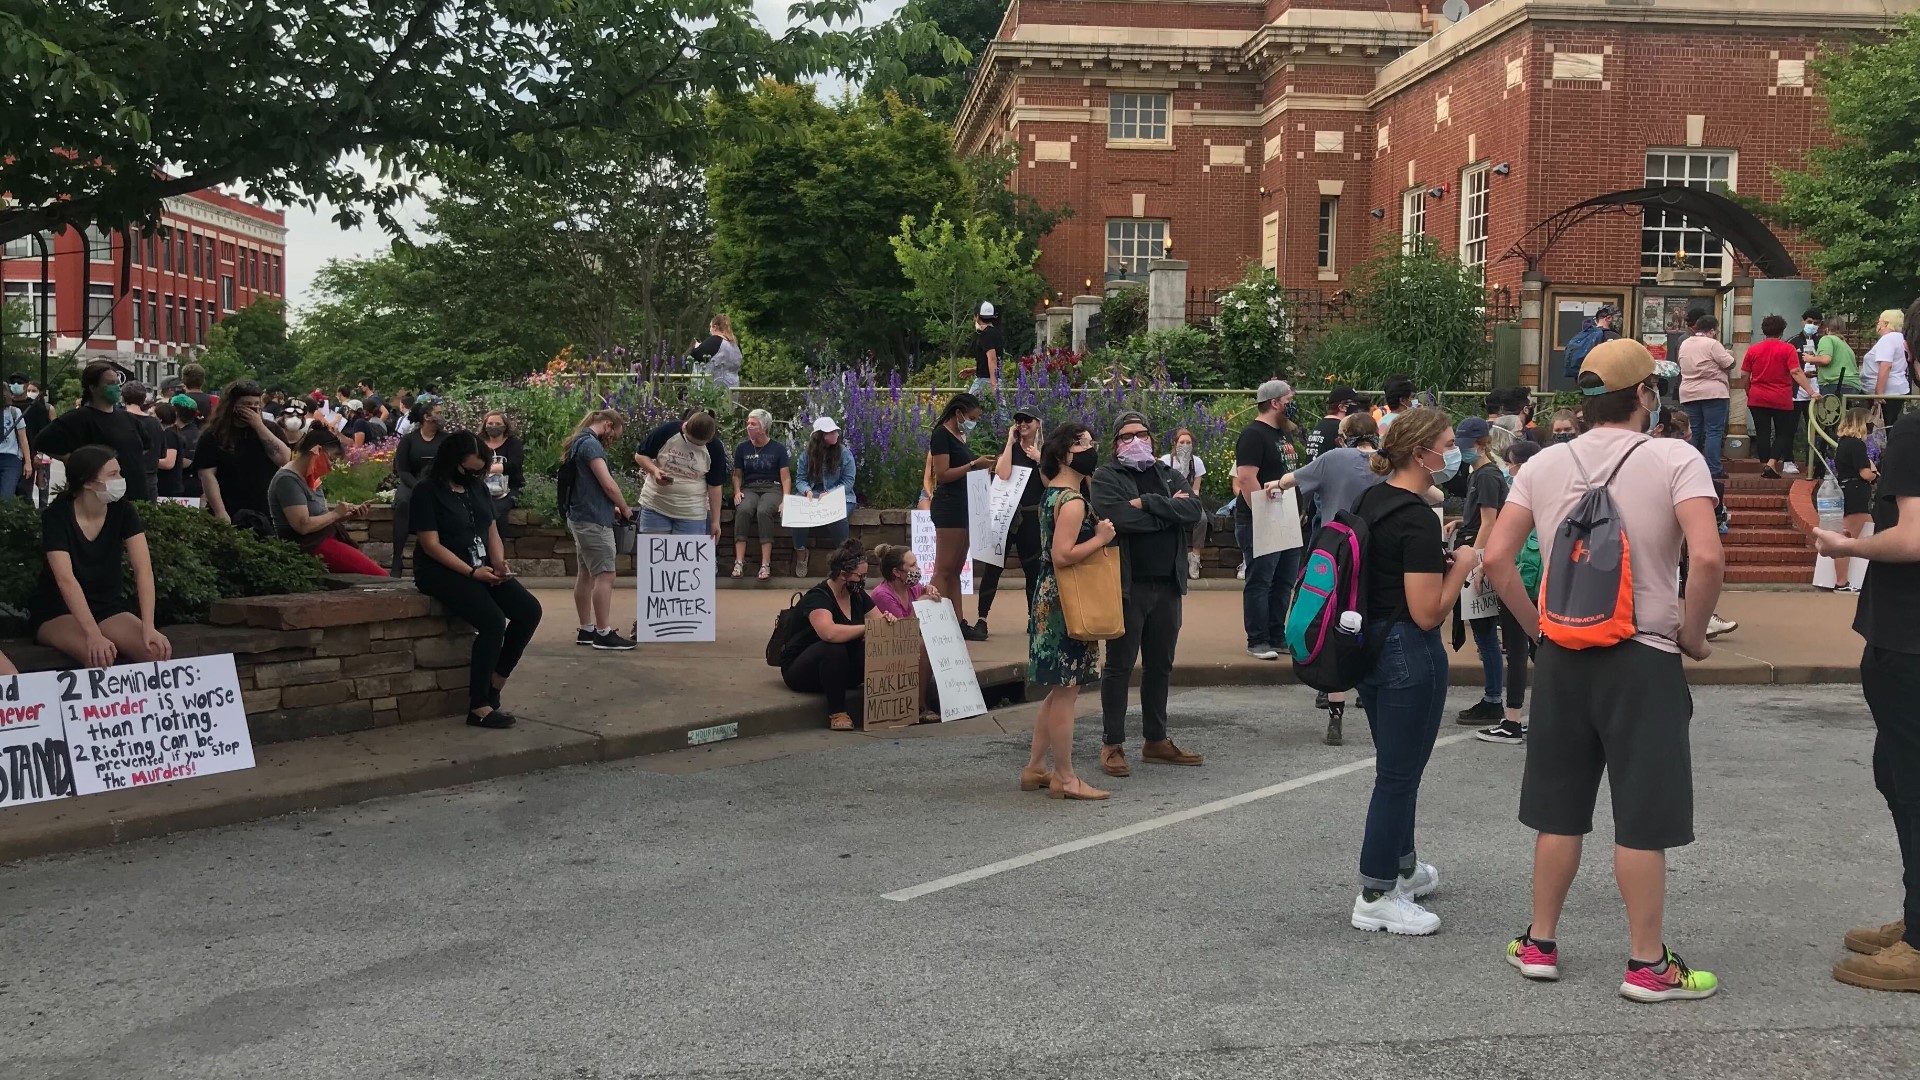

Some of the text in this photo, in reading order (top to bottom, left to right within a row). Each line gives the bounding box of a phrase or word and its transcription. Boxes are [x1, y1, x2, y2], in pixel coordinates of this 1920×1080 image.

[649, 537, 709, 565] BLACK
[649, 566, 701, 593] LIVES
[646, 595, 712, 620] MATTER.
[866, 619, 887, 638] ALL
[57, 661, 201, 701] 2 Reminders:
[866, 674, 896, 696] BLACK
[897, 670, 920, 690] LIVES
[83, 696, 148, 721] Murder
[157, 692, 174, 710] is
[182, 686, 235, 710] worse
[866, 695, 915, 721] MATTER
[87, 720, 135, 742] than
[695, 729, 711, 740] HOUR
[92, 740, 156, 764] Rioting
[196, 733, 214, 747] be
[95, 753, 165, 779] prevented
[171, 750, 181, 764] if
[184, 748, 206, 766] you
[102, 761, 197, 790] the Murders!
